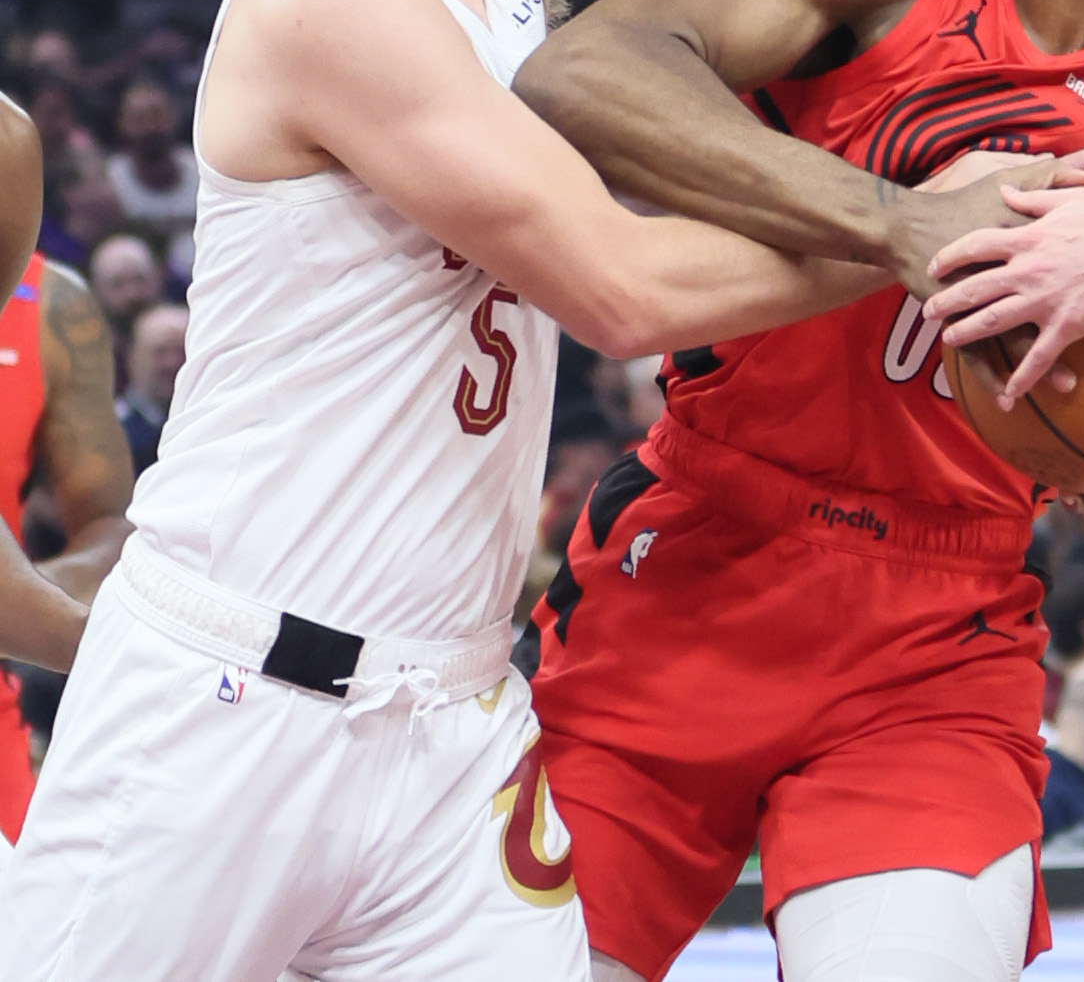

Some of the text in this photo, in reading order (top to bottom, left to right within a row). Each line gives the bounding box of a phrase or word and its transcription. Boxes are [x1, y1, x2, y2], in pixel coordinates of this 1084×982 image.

[453, 281, 518, 436] 5
[883, 291, 954, 400] 0
[808, 498, 888, 541] ripcity
